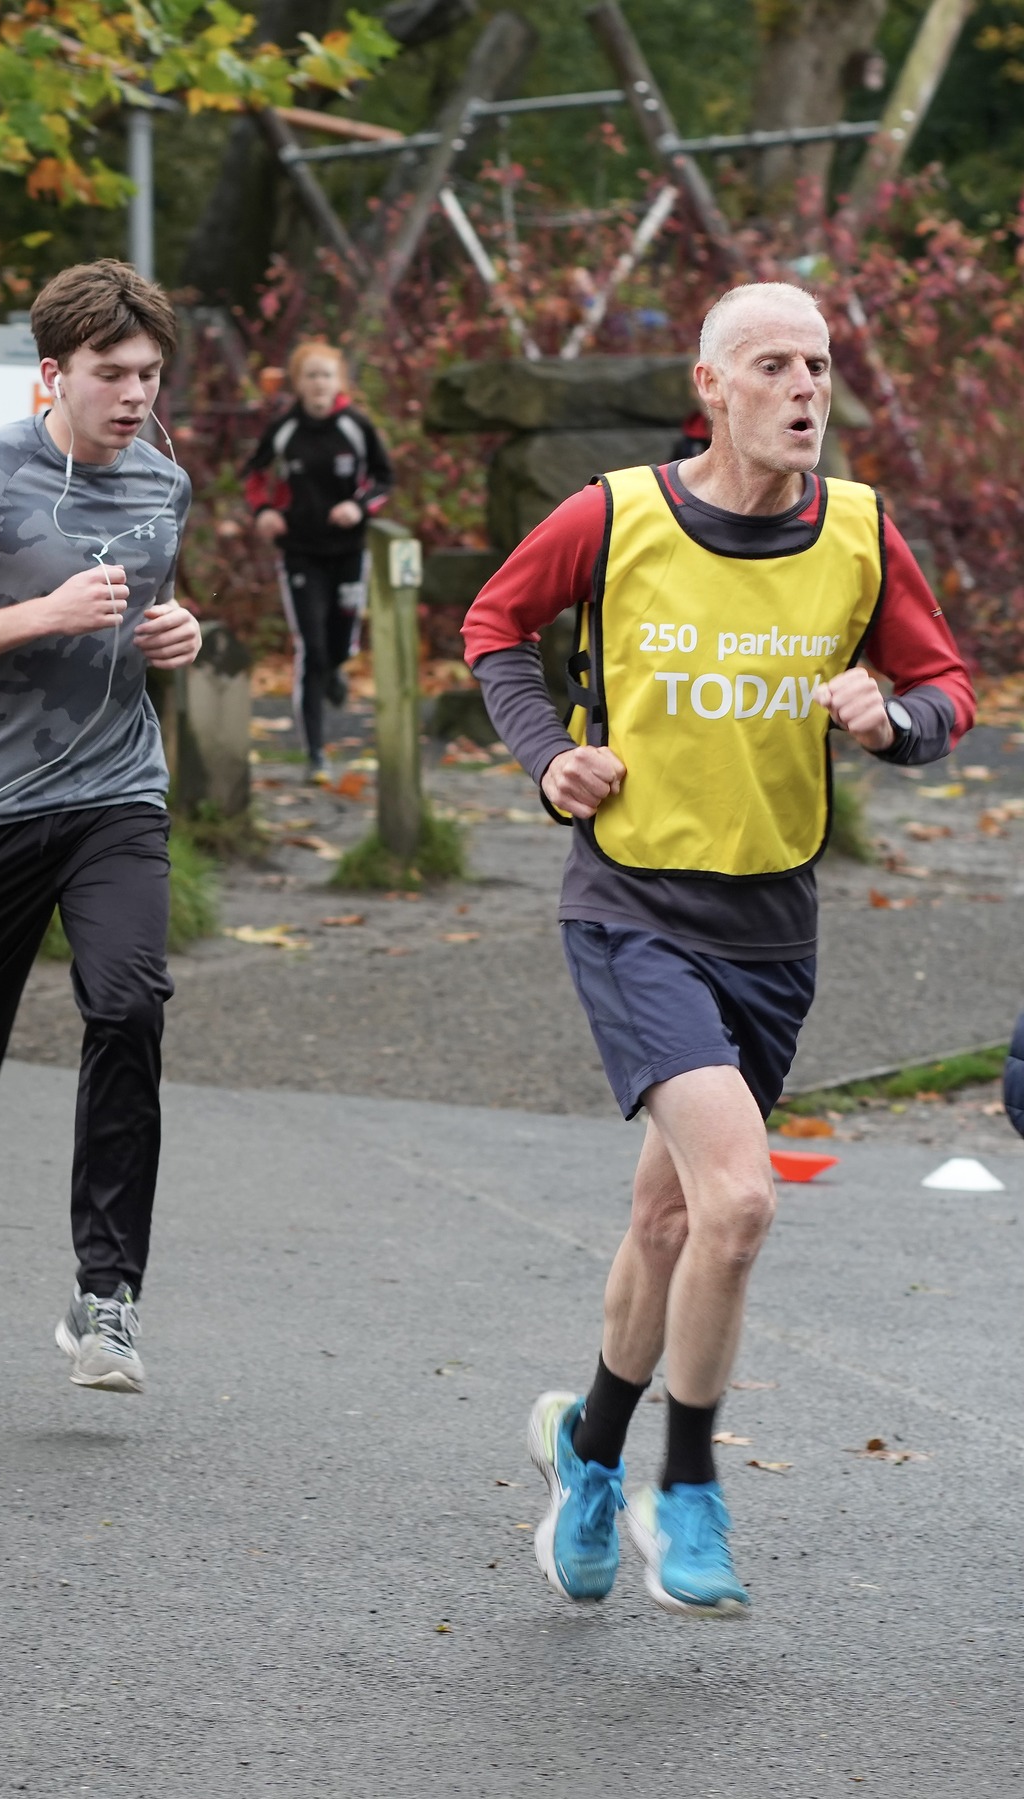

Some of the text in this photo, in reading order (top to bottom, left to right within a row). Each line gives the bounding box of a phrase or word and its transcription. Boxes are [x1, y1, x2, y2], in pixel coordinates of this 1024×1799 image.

[639, 623, 840, 661] 250 parkruns
[654, 672, 822, 720] TODAY
